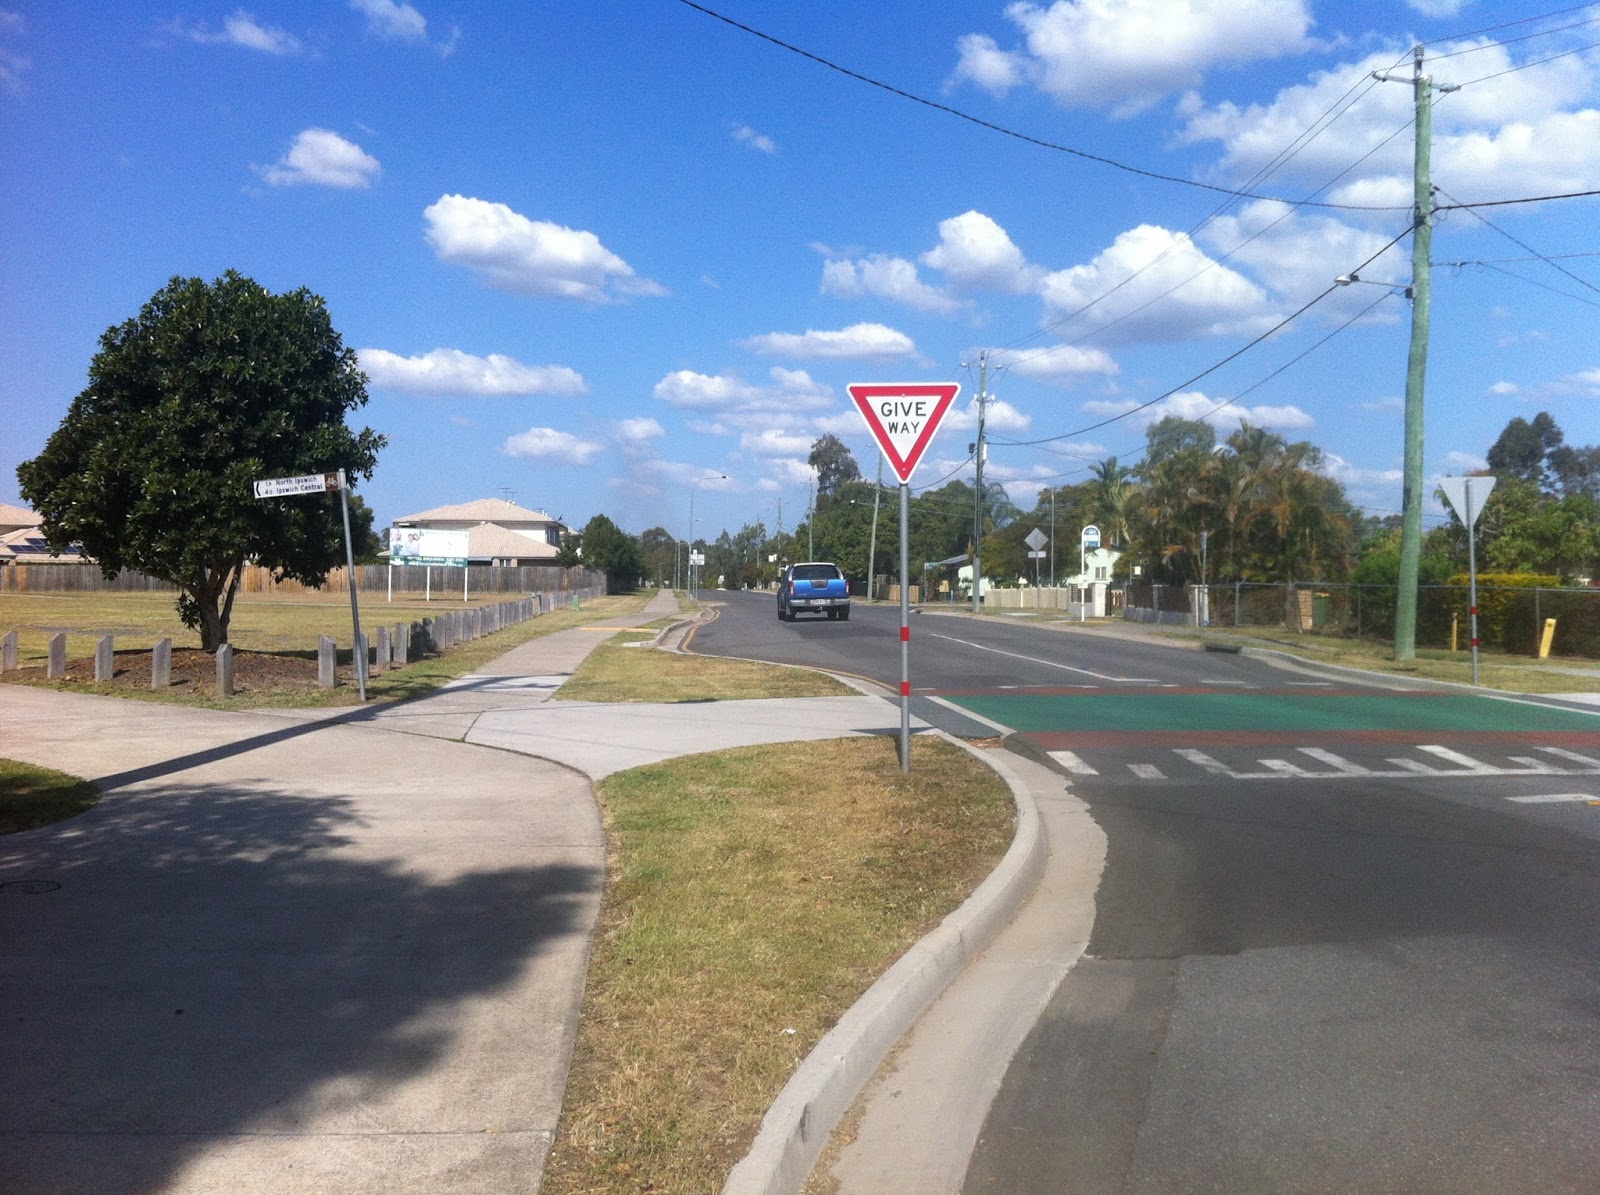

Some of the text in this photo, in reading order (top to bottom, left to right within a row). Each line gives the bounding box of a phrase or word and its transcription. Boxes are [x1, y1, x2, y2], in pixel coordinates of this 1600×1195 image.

[881, 402, 926, 417] GIVE
[888, 422, 919, 434] WAY
[295, 476, 317, 485] Ipswich
[276, 486, 299, 494] Ipswich
[300, 483, 323, 491] Central
